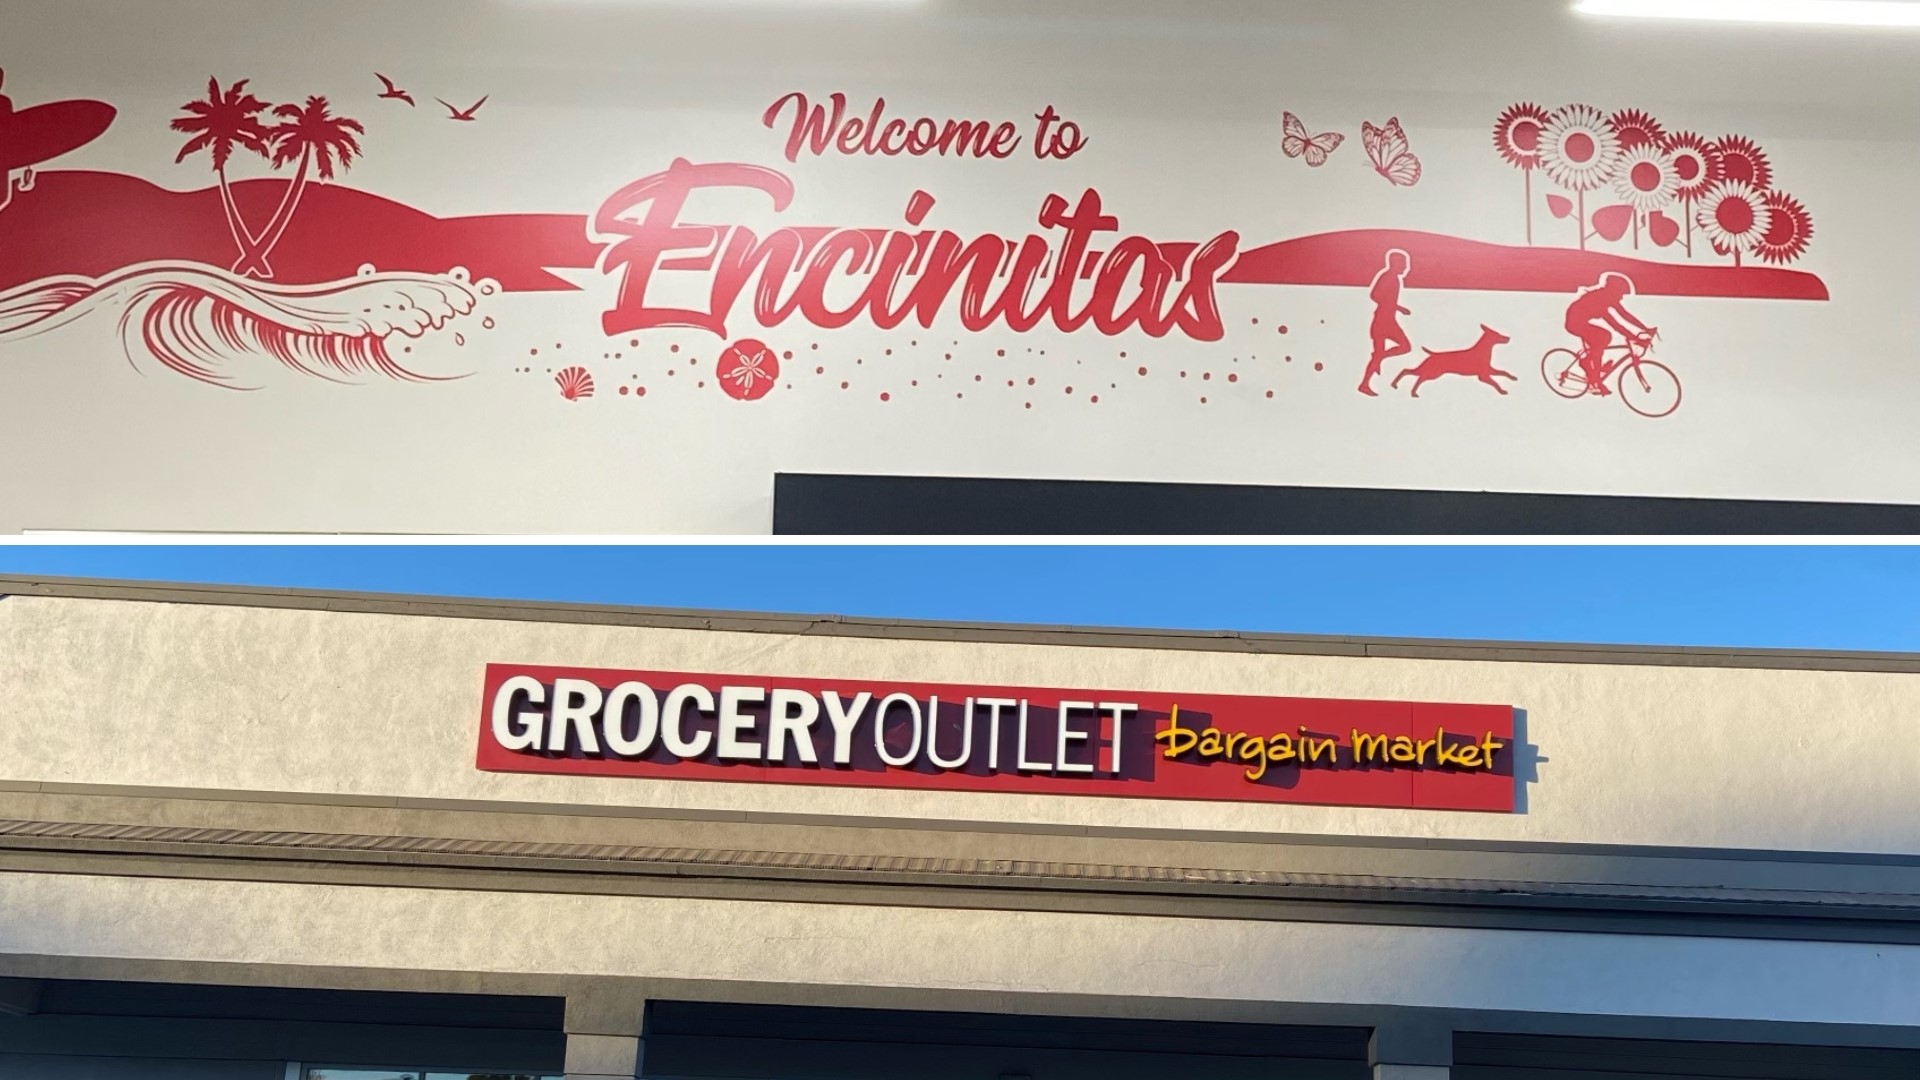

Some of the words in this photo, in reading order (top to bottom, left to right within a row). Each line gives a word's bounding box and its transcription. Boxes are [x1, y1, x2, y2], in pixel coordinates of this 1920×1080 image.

[762, 91, 1022, 164] Welcome
[1034, 104, 1089, 161] to
[594, 157, 1241, 342] Encinitas
[1155, 703, 1337, 780] bargain
[1351, 726, 1504, 770] market
